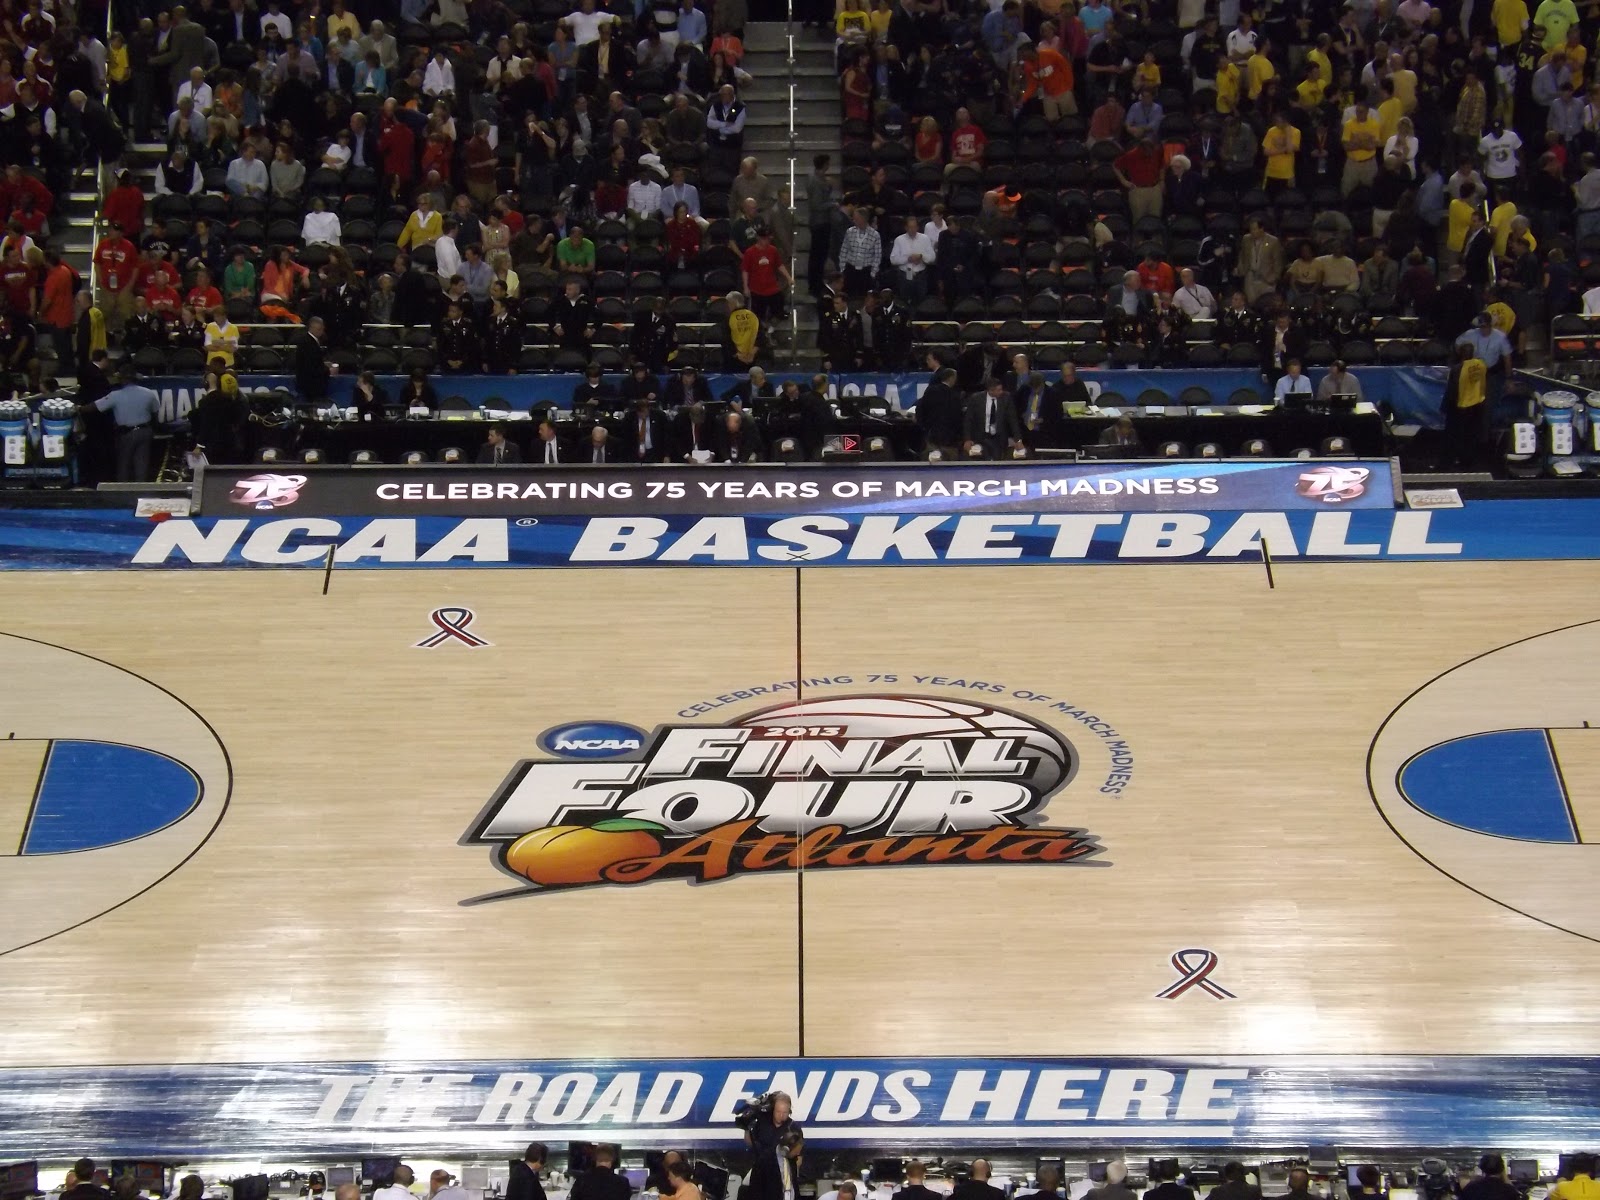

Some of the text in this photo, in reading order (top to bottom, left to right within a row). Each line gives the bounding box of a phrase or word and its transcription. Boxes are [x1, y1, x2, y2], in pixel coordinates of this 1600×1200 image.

[1519, 52, 1535, 71] 34
[376, 478, 1220, 501] CELEBRATING 75 YEARS OF MARCH MADNESS
[131, 513, 1463, 564] NCAA BASKETBALL
[554, 739, 641, 751] NCAA
[644, 728, 1030, 778] FINAL
[678, 673, 1135, 794] CELEBRATING 75 YEARS OF MARCH MADNESS
[763, 726, 841, 738] 2013
[479, 763, 1032, 840] FOUR
[602, 819, 1090, 879] Atlanta
[475, 1071, 705, 1125] ROAD
[940, 1068, 1250, 1122] HERE
